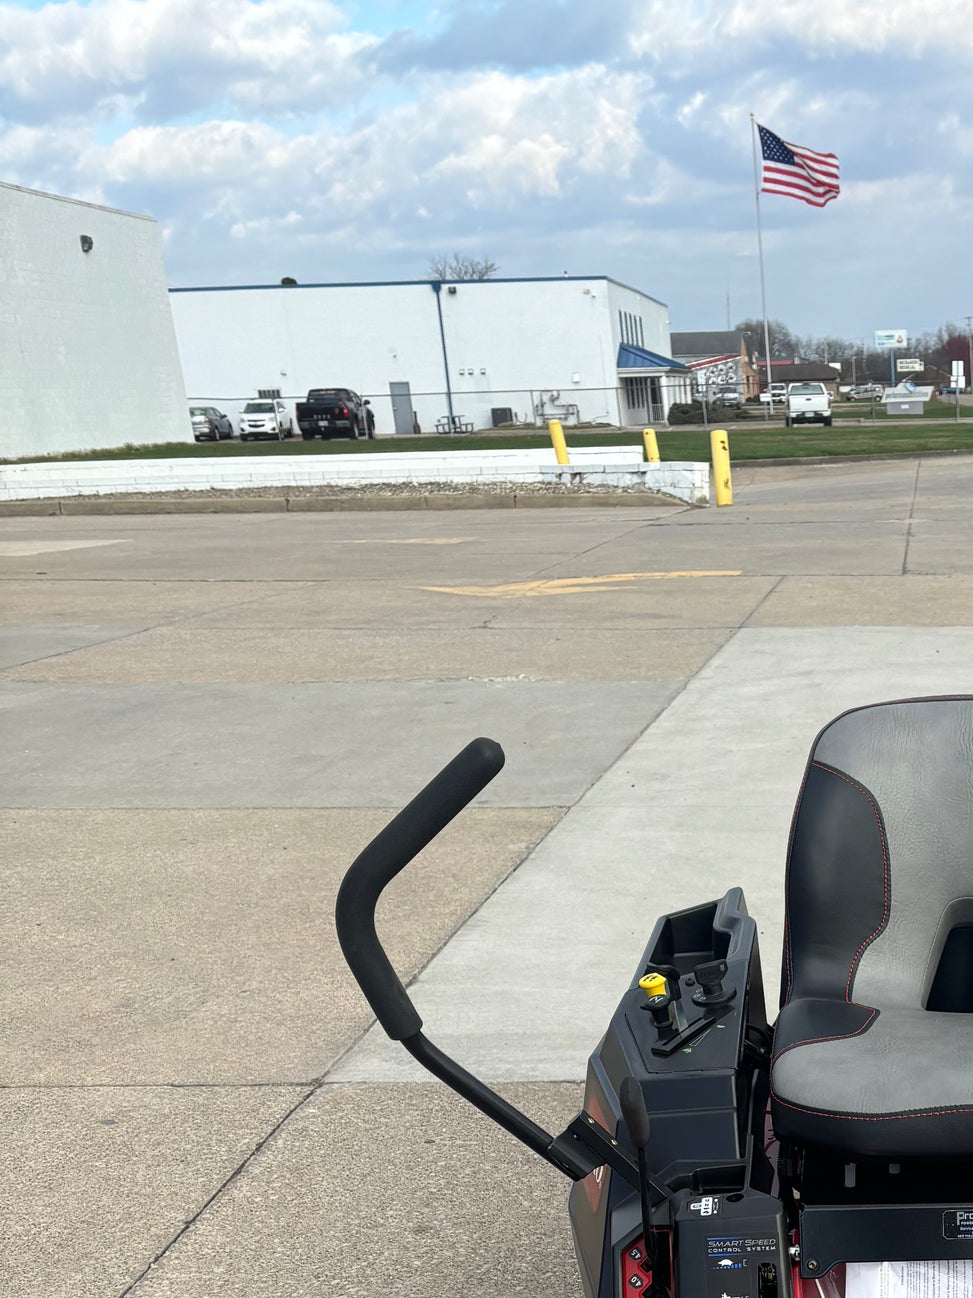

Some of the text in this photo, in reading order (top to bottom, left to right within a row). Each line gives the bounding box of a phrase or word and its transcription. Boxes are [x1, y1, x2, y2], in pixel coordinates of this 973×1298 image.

[708, 1240, 744, 1248] SMART
[631, 1248, 642, 1259] 4.5
[630, 1276, 642, 1287] 4.0
